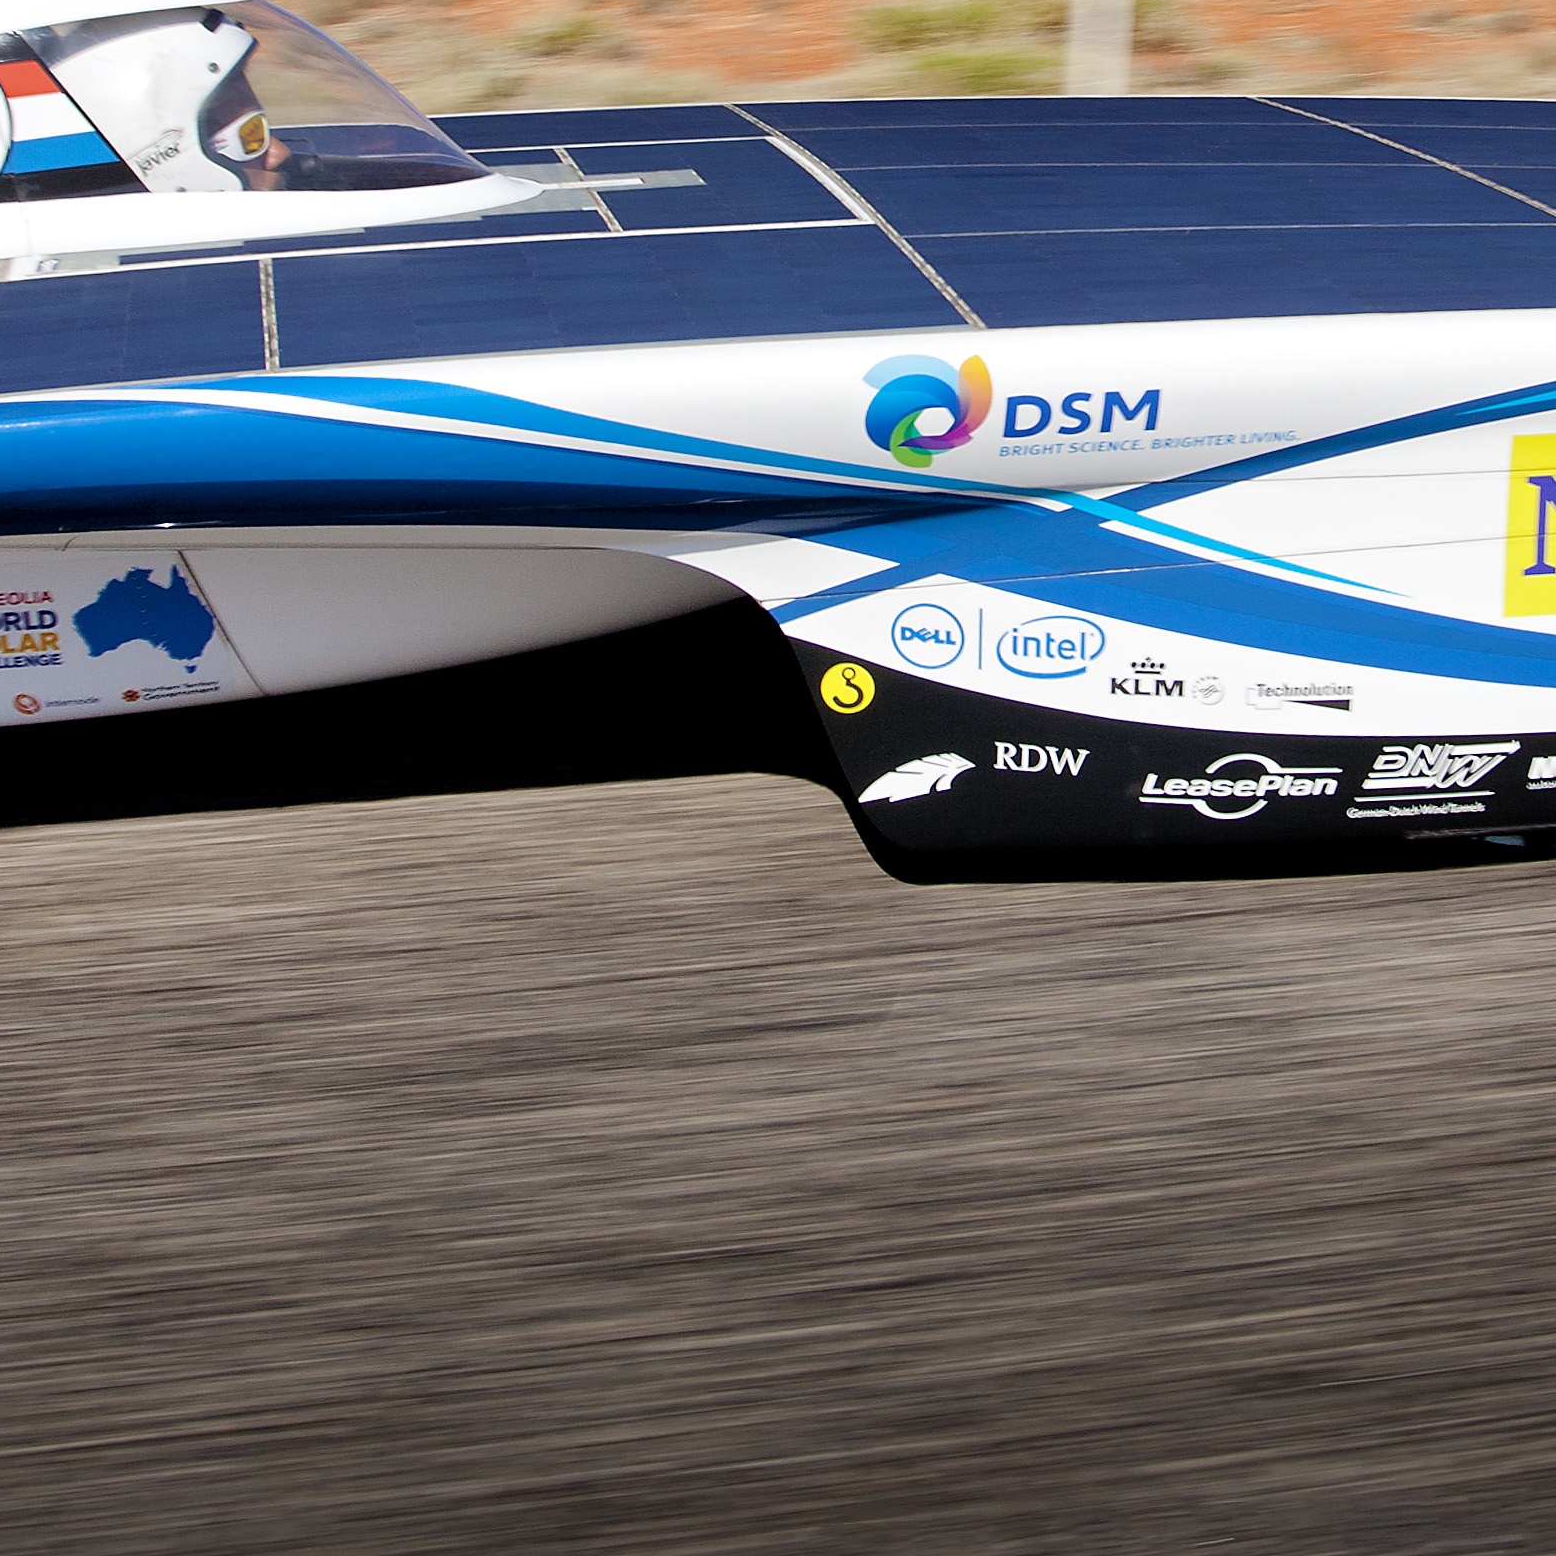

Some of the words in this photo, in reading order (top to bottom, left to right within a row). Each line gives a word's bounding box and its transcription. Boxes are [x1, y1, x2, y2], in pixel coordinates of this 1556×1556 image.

[1003, 388, 1161, 439] DSM
[999, 443, 1063, 458] BRIGHT
[1067, 439, 1146, 454] SCIENCE.
[1150, 434, 1235, 451] BRIGHTER
[1239, 429, 1300, 446] LIVING.
[900, 626, 957, 646] DELL
[1011, 627, 1088, 661] intel
[1110, 677, 1186, 698] KLM
[1256, 683, 1354, 698] Technolution
[994, 741, 1090, 776] RDW
[1367, 743, 1508, 789] DNW
[1142, 772, 1339, 797] LeasePlan
